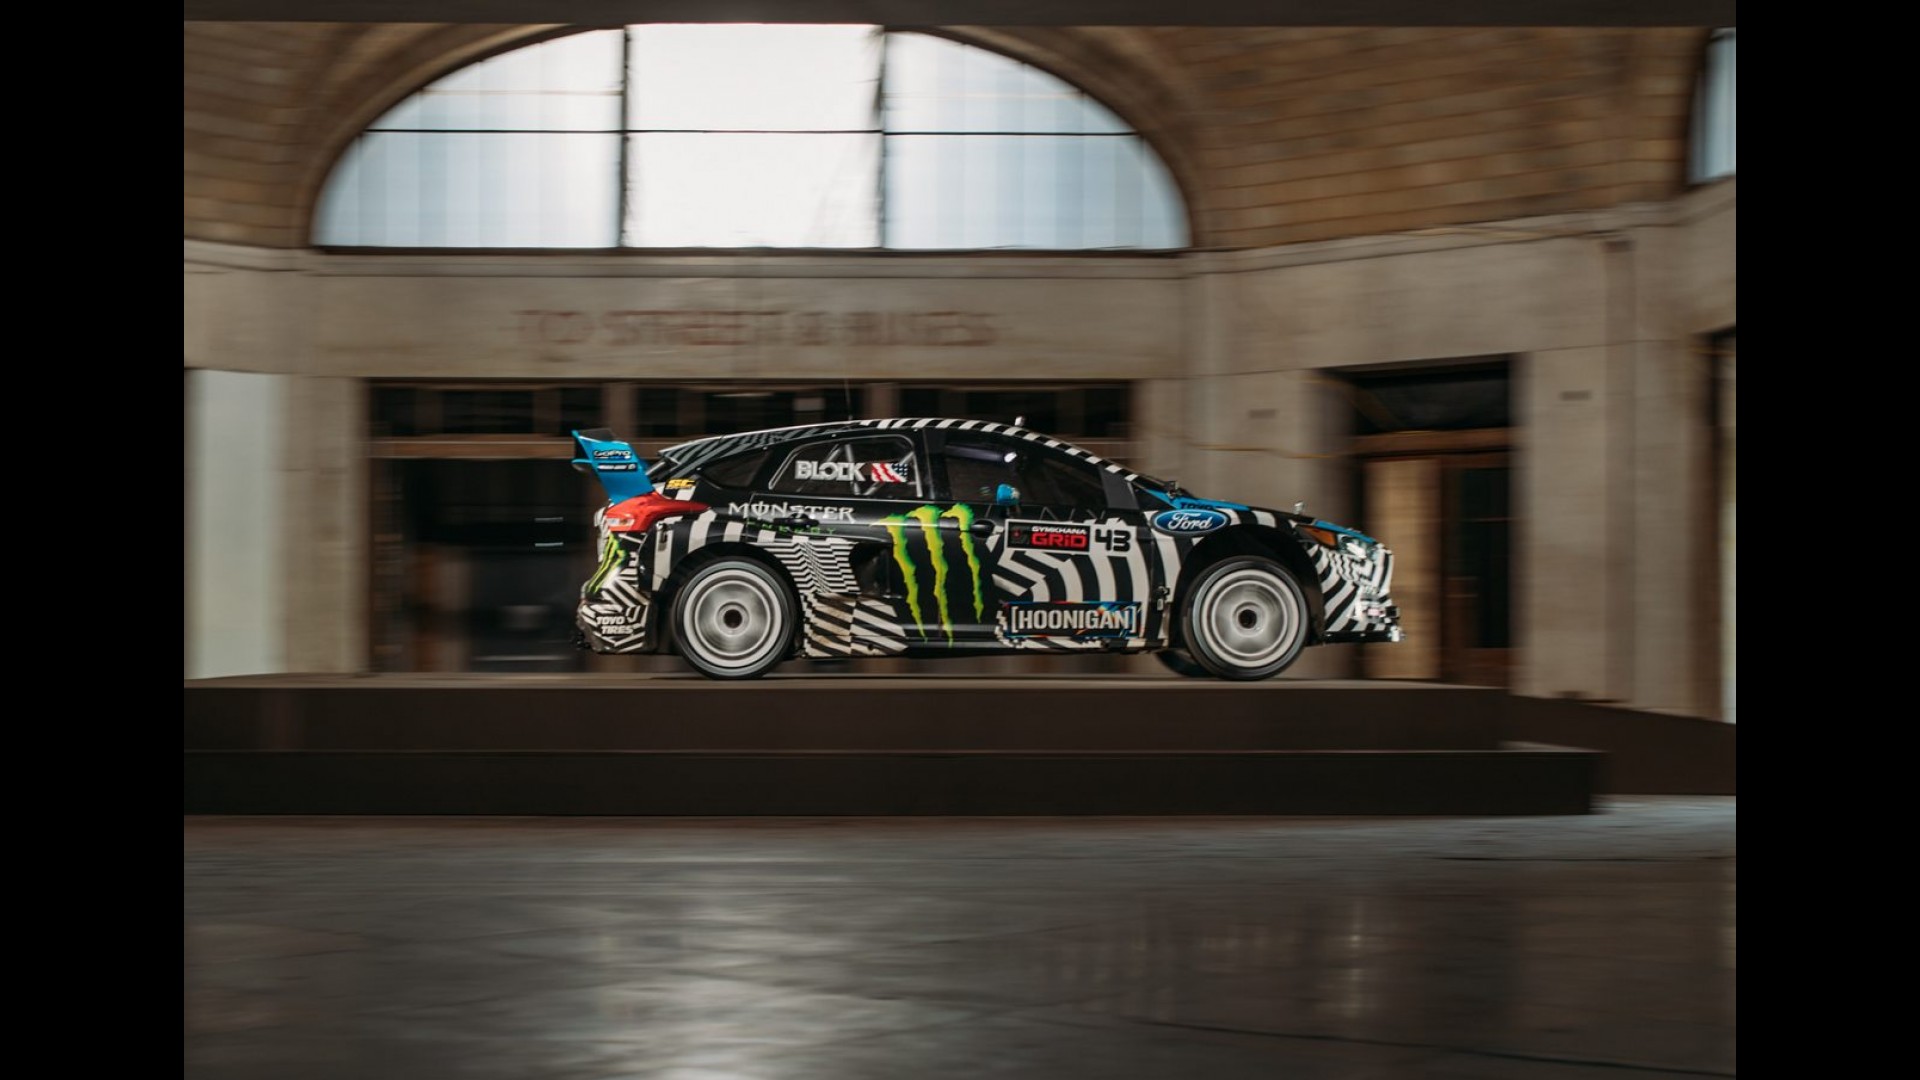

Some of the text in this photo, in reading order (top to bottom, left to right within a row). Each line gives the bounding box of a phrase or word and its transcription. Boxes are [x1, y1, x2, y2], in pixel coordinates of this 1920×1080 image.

[795, 460, 866, 481] BLOCK
[728, 501, 855, 524] MONSTER
[1168, 512, 1213, 530] Ford
[1031, 525, 1087, 535] GYMKHANA
[1095, 529, 1131, 552] 43
[596, 616, 626, 625] TOYO
[601, 625, 634, 635] TIRES
